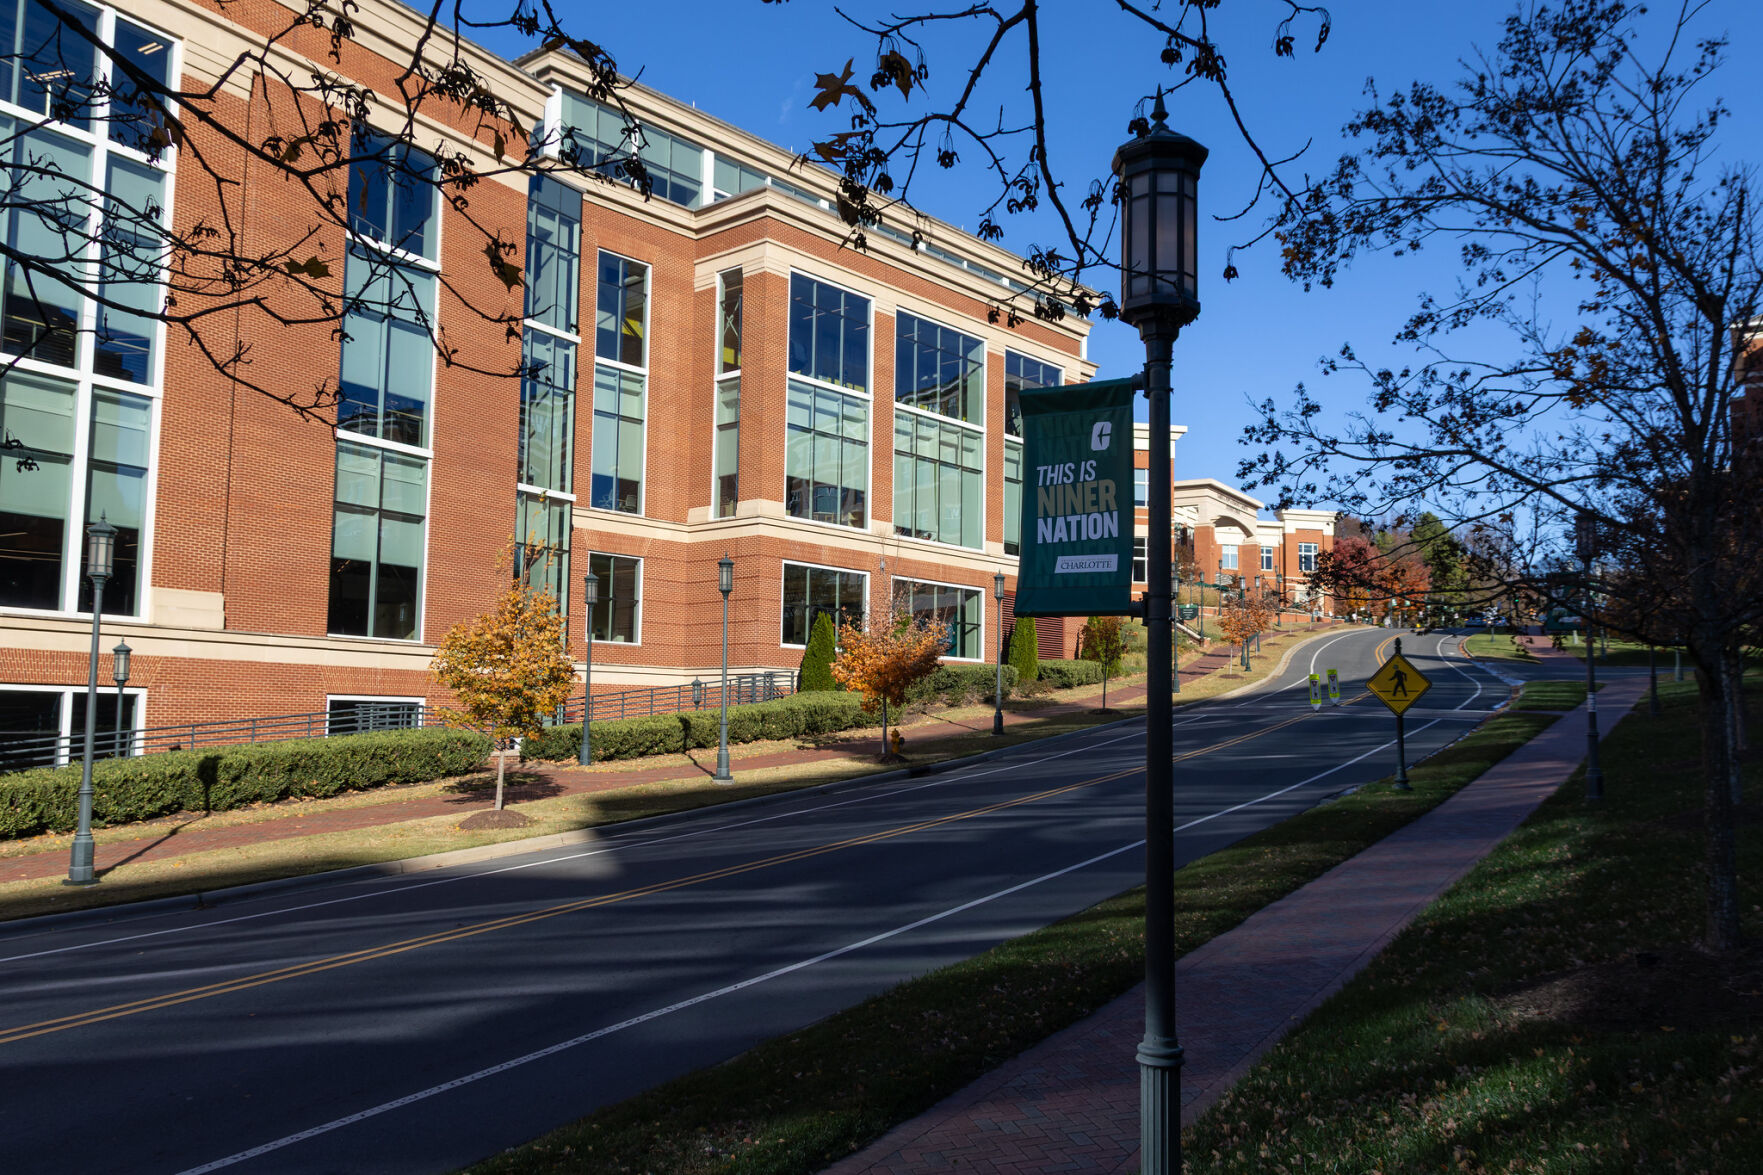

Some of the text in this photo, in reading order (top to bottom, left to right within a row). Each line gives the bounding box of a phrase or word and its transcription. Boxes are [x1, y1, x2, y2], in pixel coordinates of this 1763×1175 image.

[1036, 459, 1097, 487] THIS IS
[1037, 479, 1118, 517] NINER
[1037, 510, 1119, 544] NATION
[1060, 560, 1112, 570] CHARLOTTE
